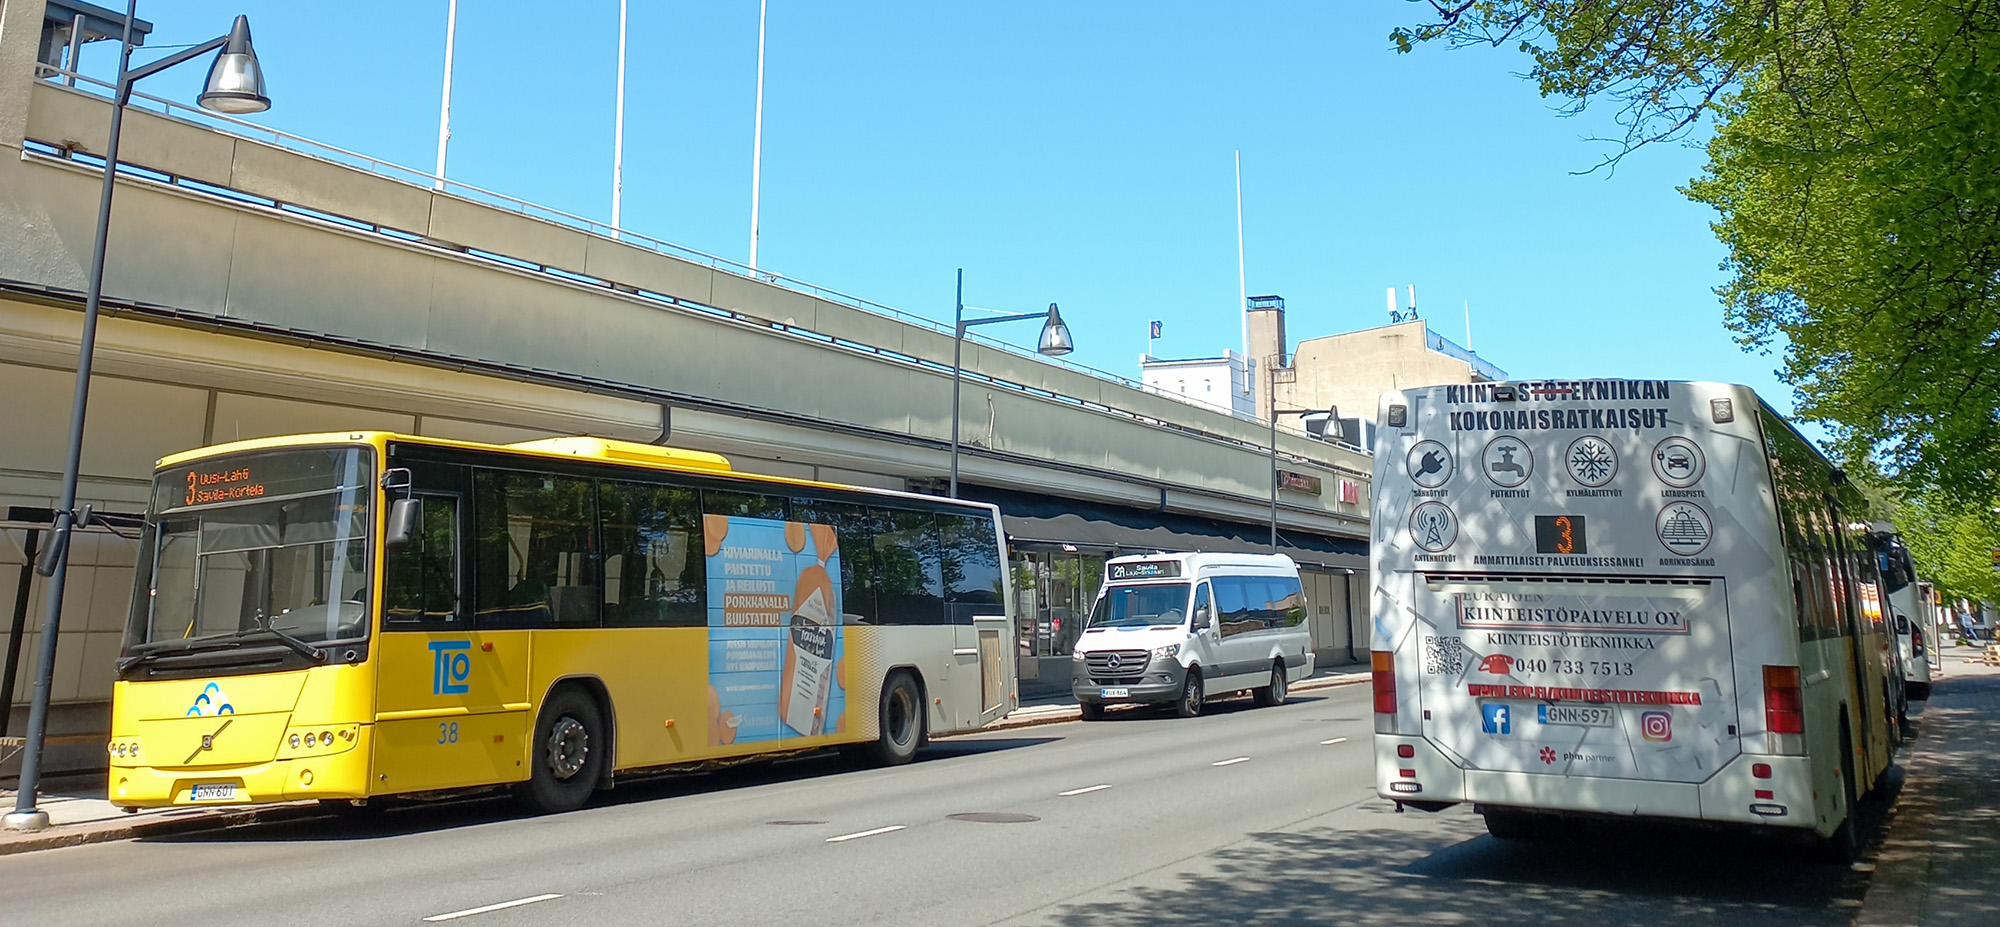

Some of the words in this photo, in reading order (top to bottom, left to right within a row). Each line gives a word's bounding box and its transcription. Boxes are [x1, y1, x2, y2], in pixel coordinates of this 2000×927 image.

[1446, 380, 1671, 404] KIINTSTÖTEKNIIKAN
[1450, 408, 1669, 431] KOKONAISRATKAISUT
[185, 471, 197, 505] 3
[1413, 489, 1448, 498] SÄHKÖTYÖT
[1490, 489, 1530, 498] PUTKITYÖT
[1566, 489, 1622, 498] KYLMÄLAITETYÖT
[1661, 489, 1705, 498] LATAUSPISTE
[1556, 515, 1573, 555] 3
[723, 546, 783, 561] KIVIARINALLA
[1414, 554, 1456, 563] ANTENNITYÖT
[1473, 555, 1544, 566] AMMATTILAISET
[1547, 556, 1644, 568] PALVELUKSESSANNE!
[1659, 557, 1715, 567] AURINKOSÄHKÖ
[724, 563, 771, 576] PAISTETTU
[1114, 566, 1126, 577] 2A
[726, 580, 735, 592] JA
[739, 580, 775, 593] REILUSTI
[725, 595, 789, 609] PORKKANALLA
[725, 612, 780, 625] BUUSTATTU!
[1464, 605, 1649, 625] KIINTEISTÖPALVELU
[1655, 611, 1681, 625] OY
[1487, 632, 1656, 650] KIINTEISTÖTEKNIIKKA
[1516, 659, 1546, 673] 040
[1552, 660, 1584, 675] 733
[1590, 661, 1633, 676] 7513
[1549, 708, 1609, 724] GNN-597
[437, 722, 459, 744] 38
[1563, 751, 1583, 761] phm
